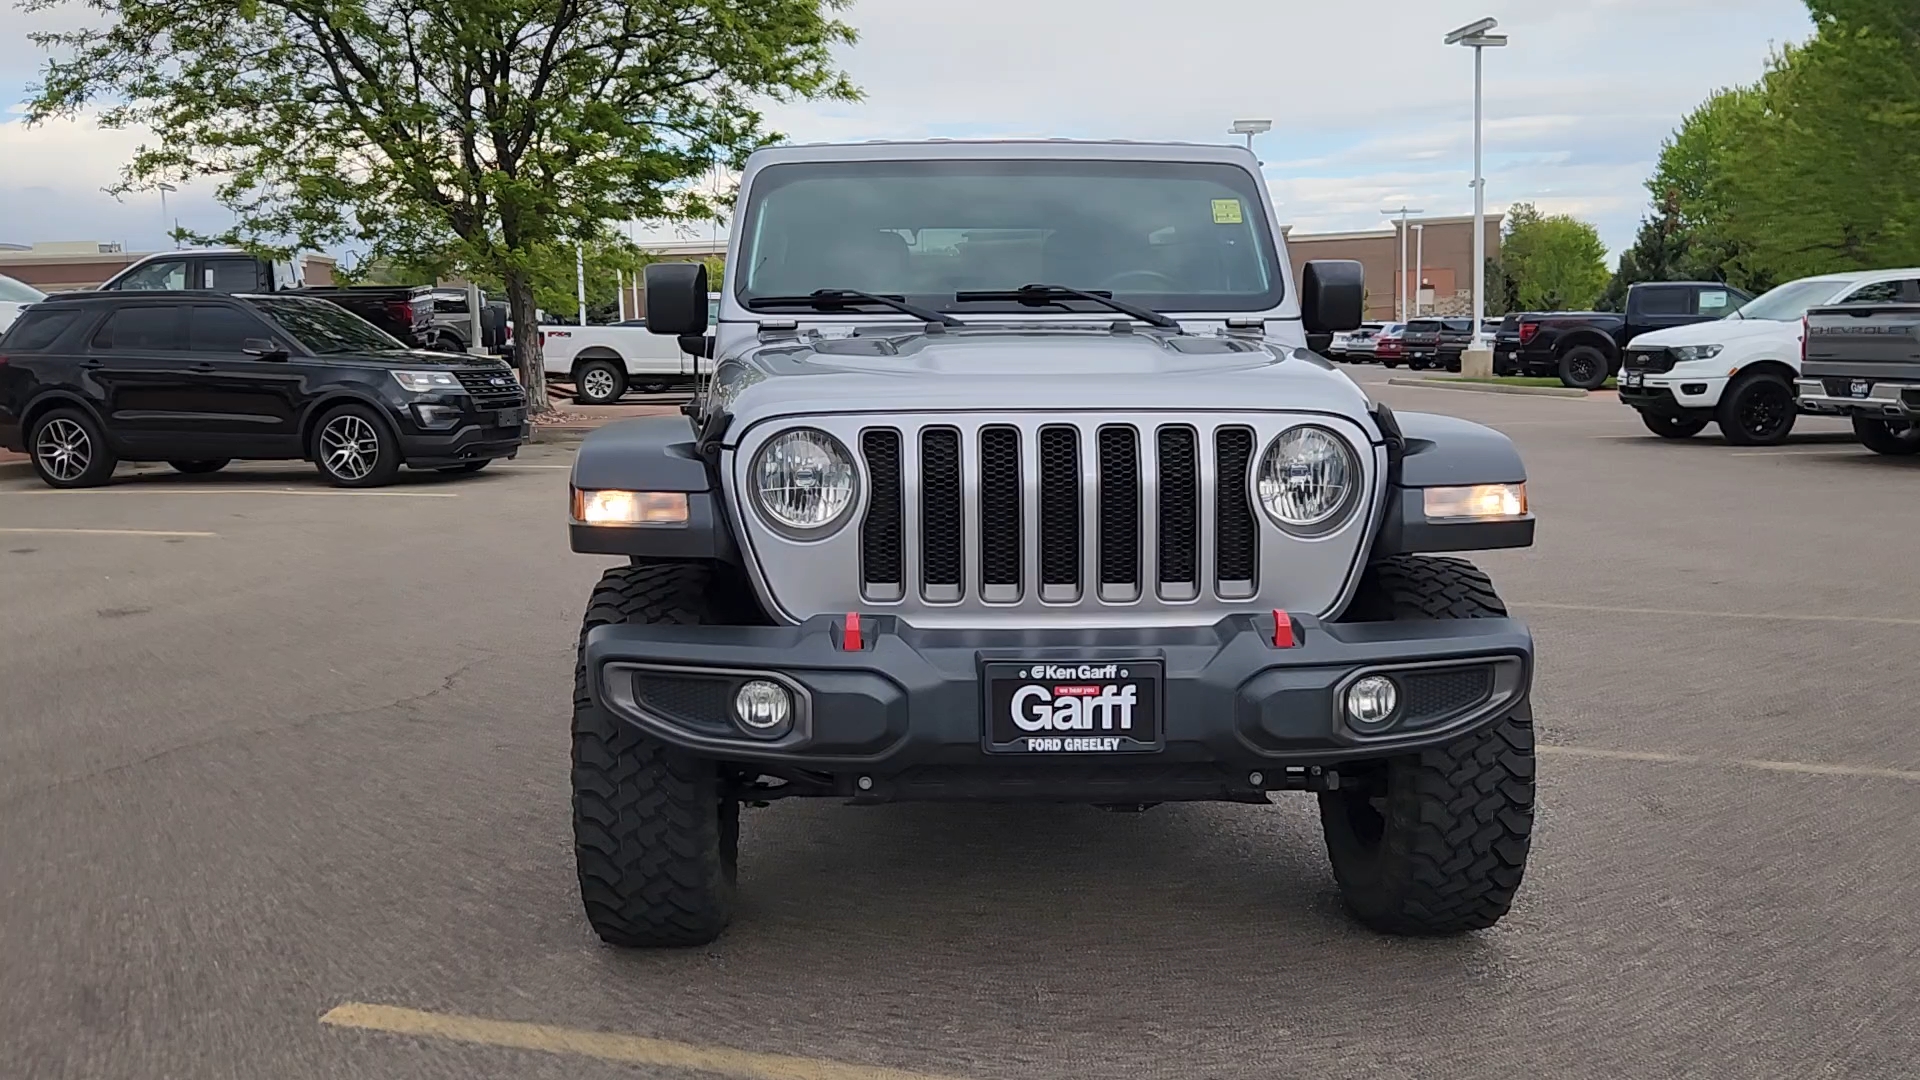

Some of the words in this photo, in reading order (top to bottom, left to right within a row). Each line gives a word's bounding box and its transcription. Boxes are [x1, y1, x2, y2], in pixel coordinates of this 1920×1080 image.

[1810, 326, 1912, 335] CHEVROLET
[1046, 665, 1076, 679] Ken
[1077, 665, 1117, 679] Garff
[1011, 684, 1137, 731] Garff
[1028, 738, 1061, 751] FORD
[1063, 738, 1120, 751] GREELEY
